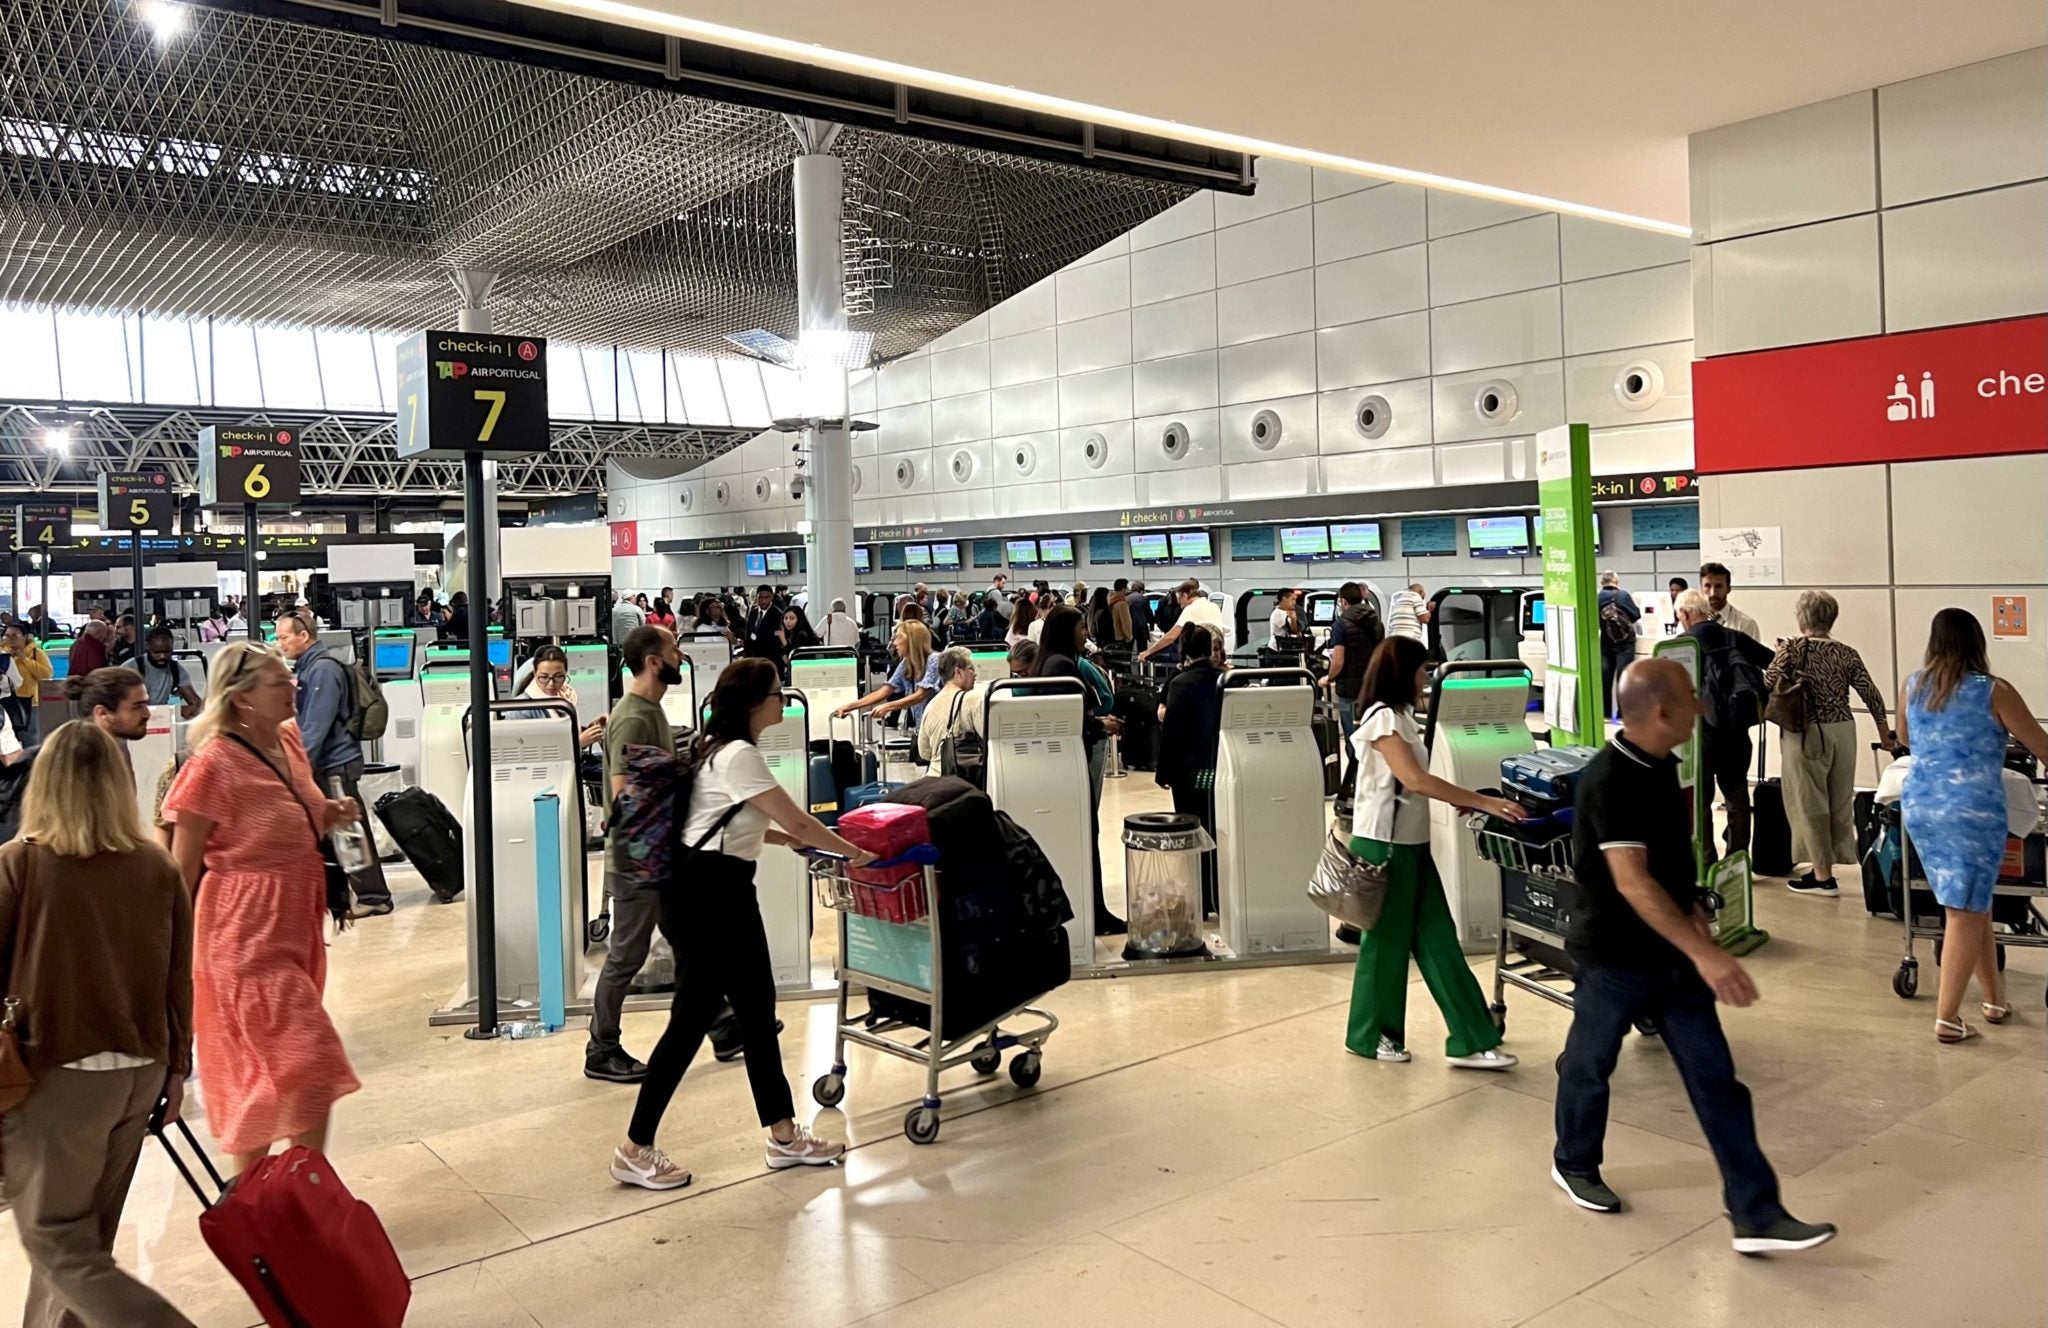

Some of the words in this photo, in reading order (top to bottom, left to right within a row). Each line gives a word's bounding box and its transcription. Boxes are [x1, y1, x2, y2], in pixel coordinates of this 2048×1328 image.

[438, 339, 501, 354] check-in
[435, 361, 468, 379] TAP
[474, 390, 506, 442] 7
[222, 431, 266, 441] check-in
[219, 445, 242, 458] TAP
[111, 475, 146, 483] check-in
[244, 463, 271, 498] 6
[1663, 476, 1688, 492] TAP
[129, 498, 150, 525] 5
[1133, 511, 1168, 523] check-in
[38, 525, 55, 544] 4
